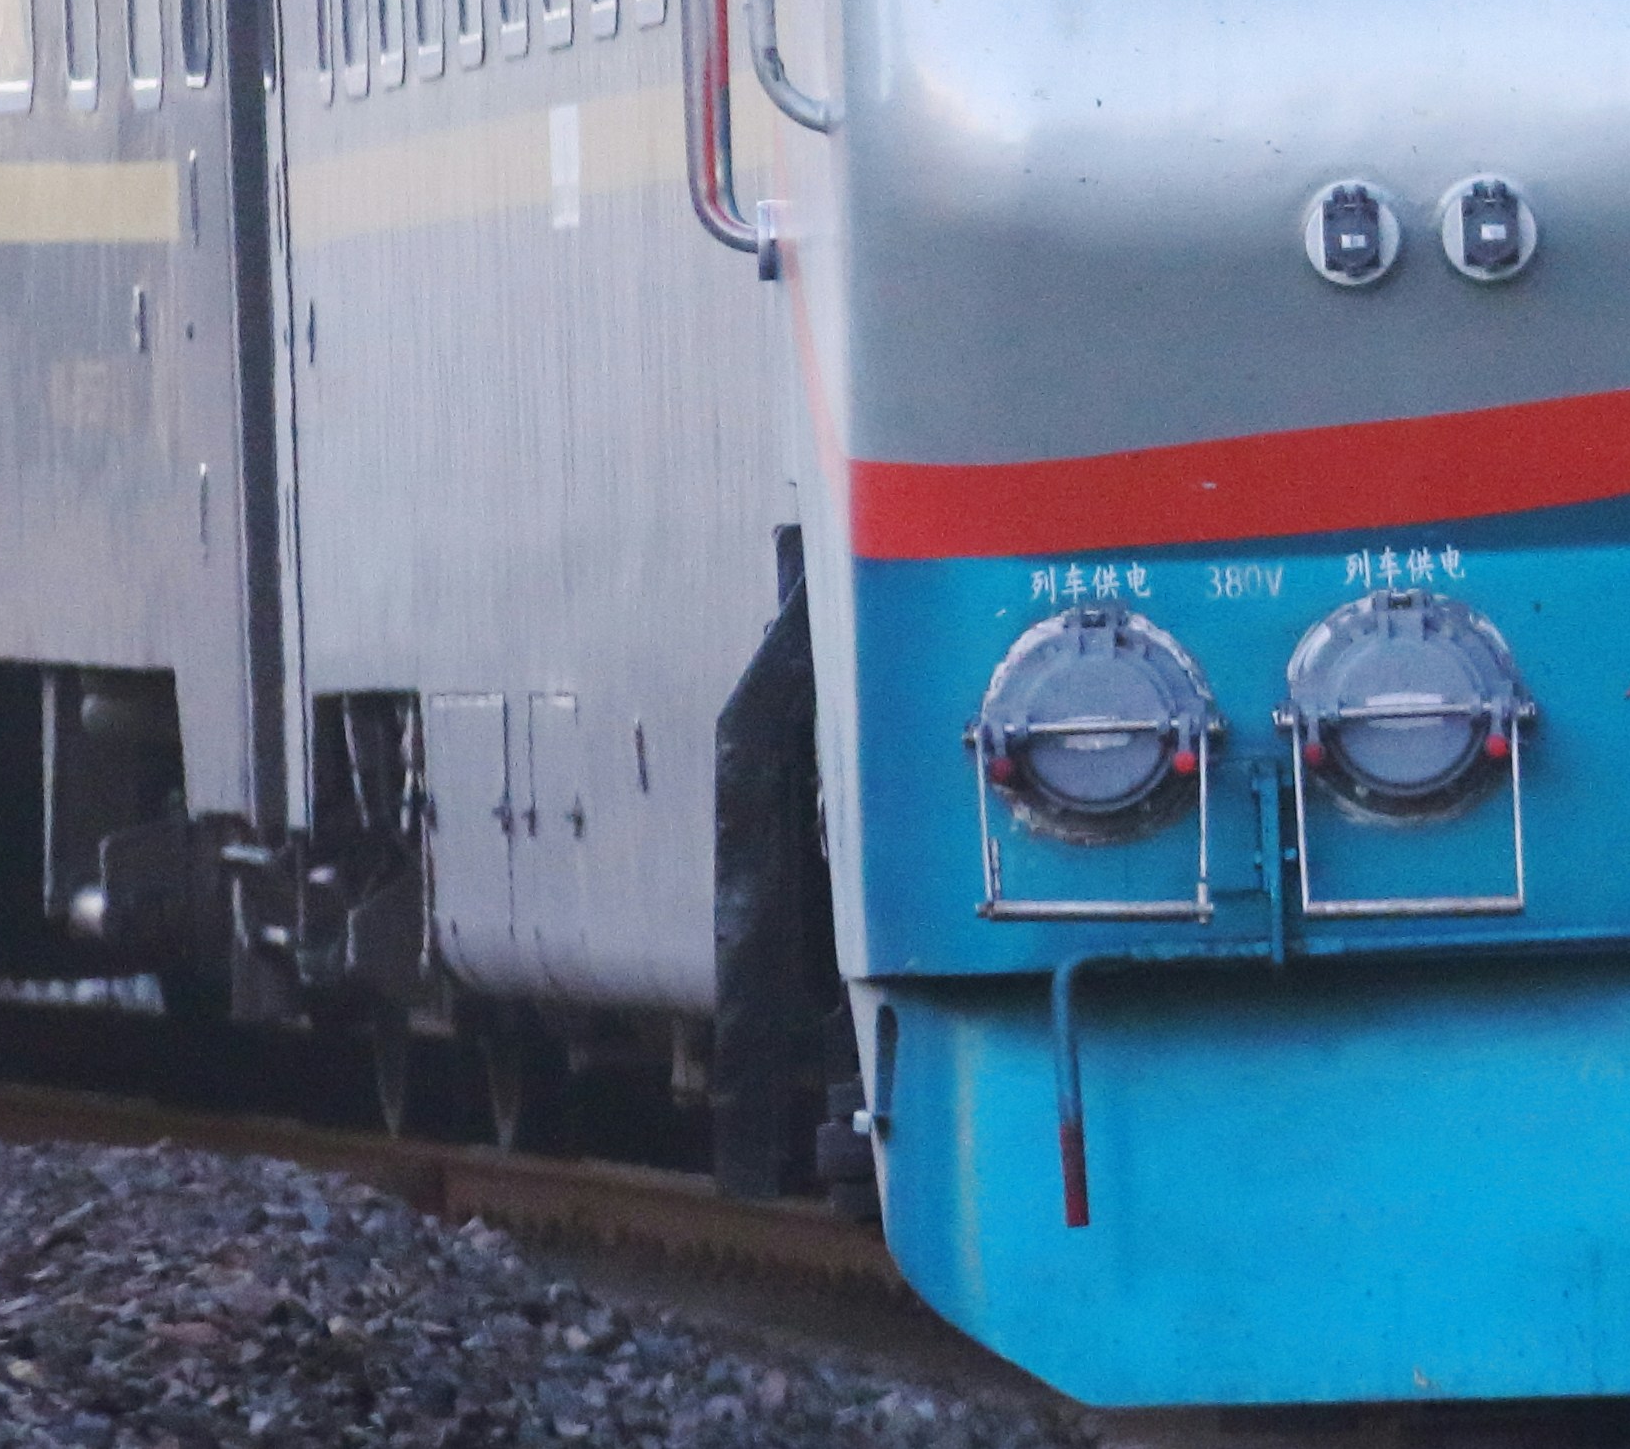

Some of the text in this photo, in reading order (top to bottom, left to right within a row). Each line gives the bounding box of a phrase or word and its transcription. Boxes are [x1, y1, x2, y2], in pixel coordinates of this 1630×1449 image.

[1030, 562, 1151, 603] 列车供电
[1208, 564, 1283, 598] 380V
[1344, 543, 1466, 589] 列车供电
